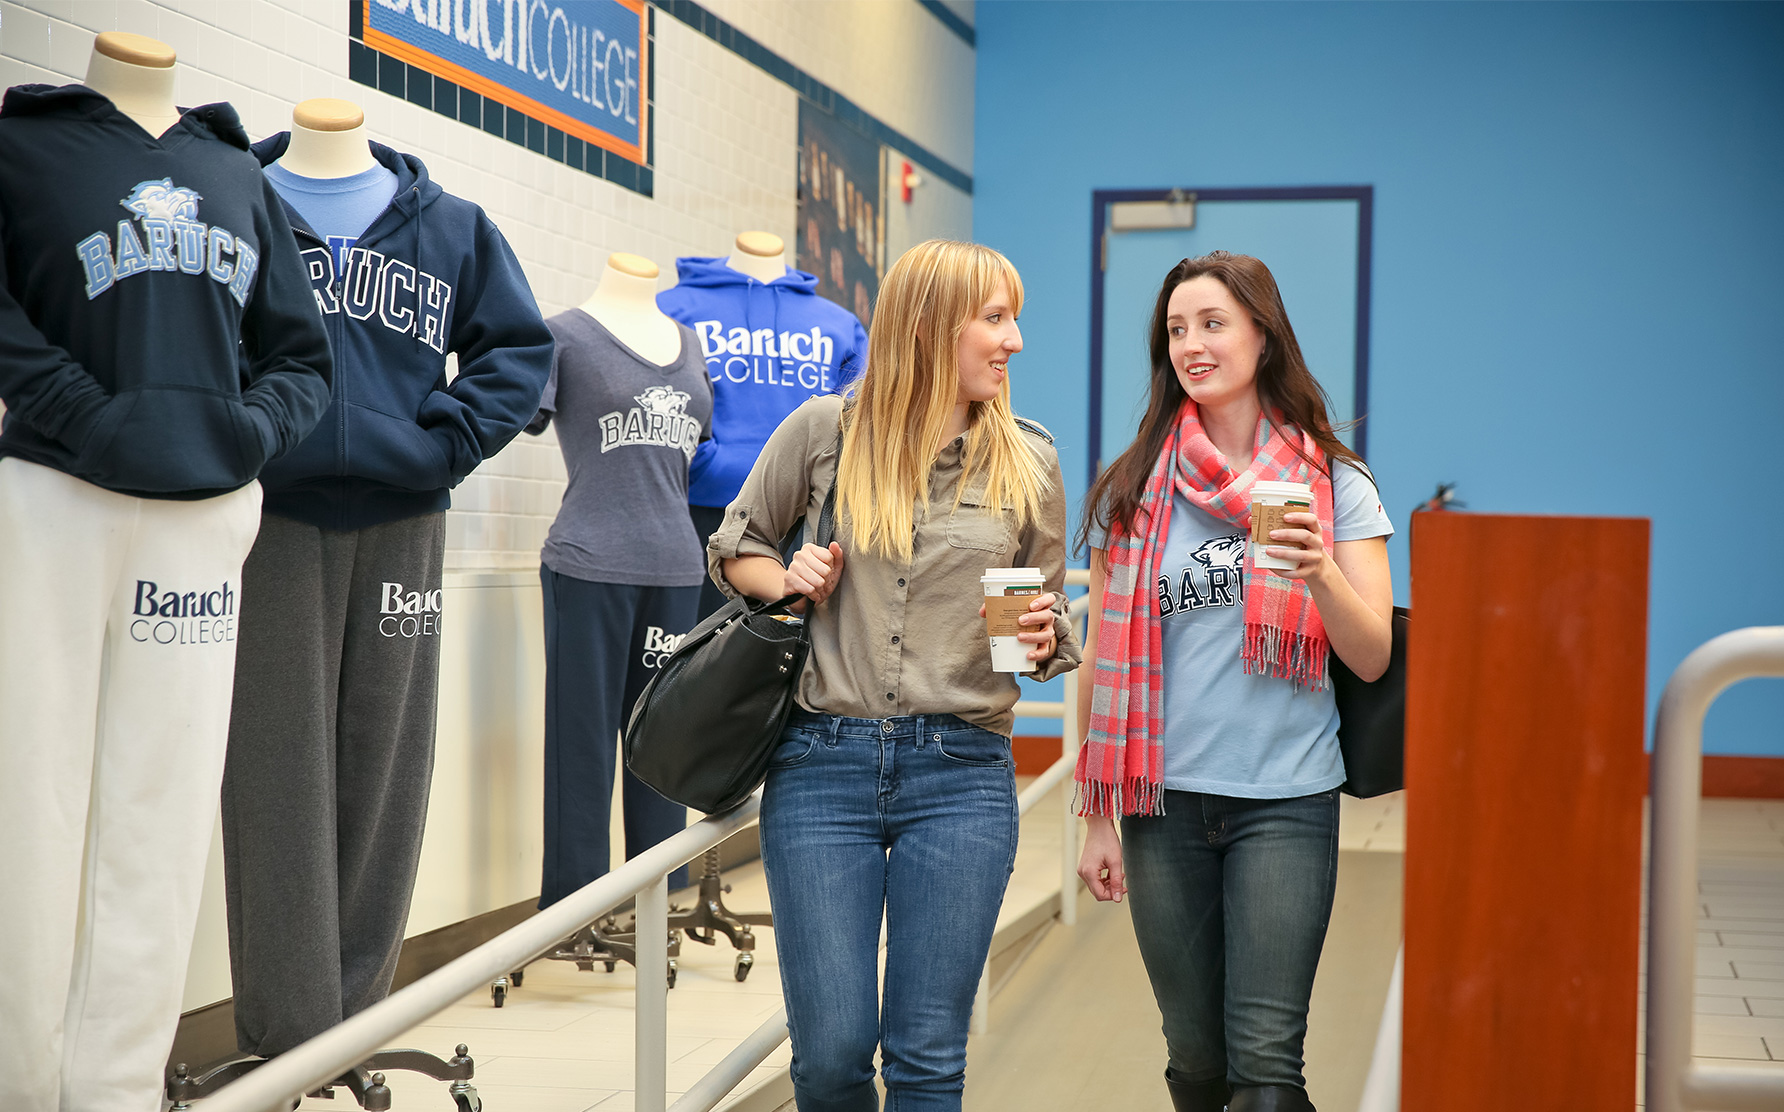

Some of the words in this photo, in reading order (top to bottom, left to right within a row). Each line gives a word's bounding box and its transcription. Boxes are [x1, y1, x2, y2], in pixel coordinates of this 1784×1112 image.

[528, 0, 637, 125] COLLEGE
[76, 218, 259, 308] BARUCH
[299, 246, 452, 355] RUCH
[694, 320, 833, 365] Baruch
[706, 356, 832, 391] COLLEGE
[598, 407, 702, 461] BARUC
[133, 580, 234, 618] Baruch
[380, 582, 442, 614] Bauc
[1158, 564, 1243, 620] BAR
[130, 618, 235, 644] COLLEGE
